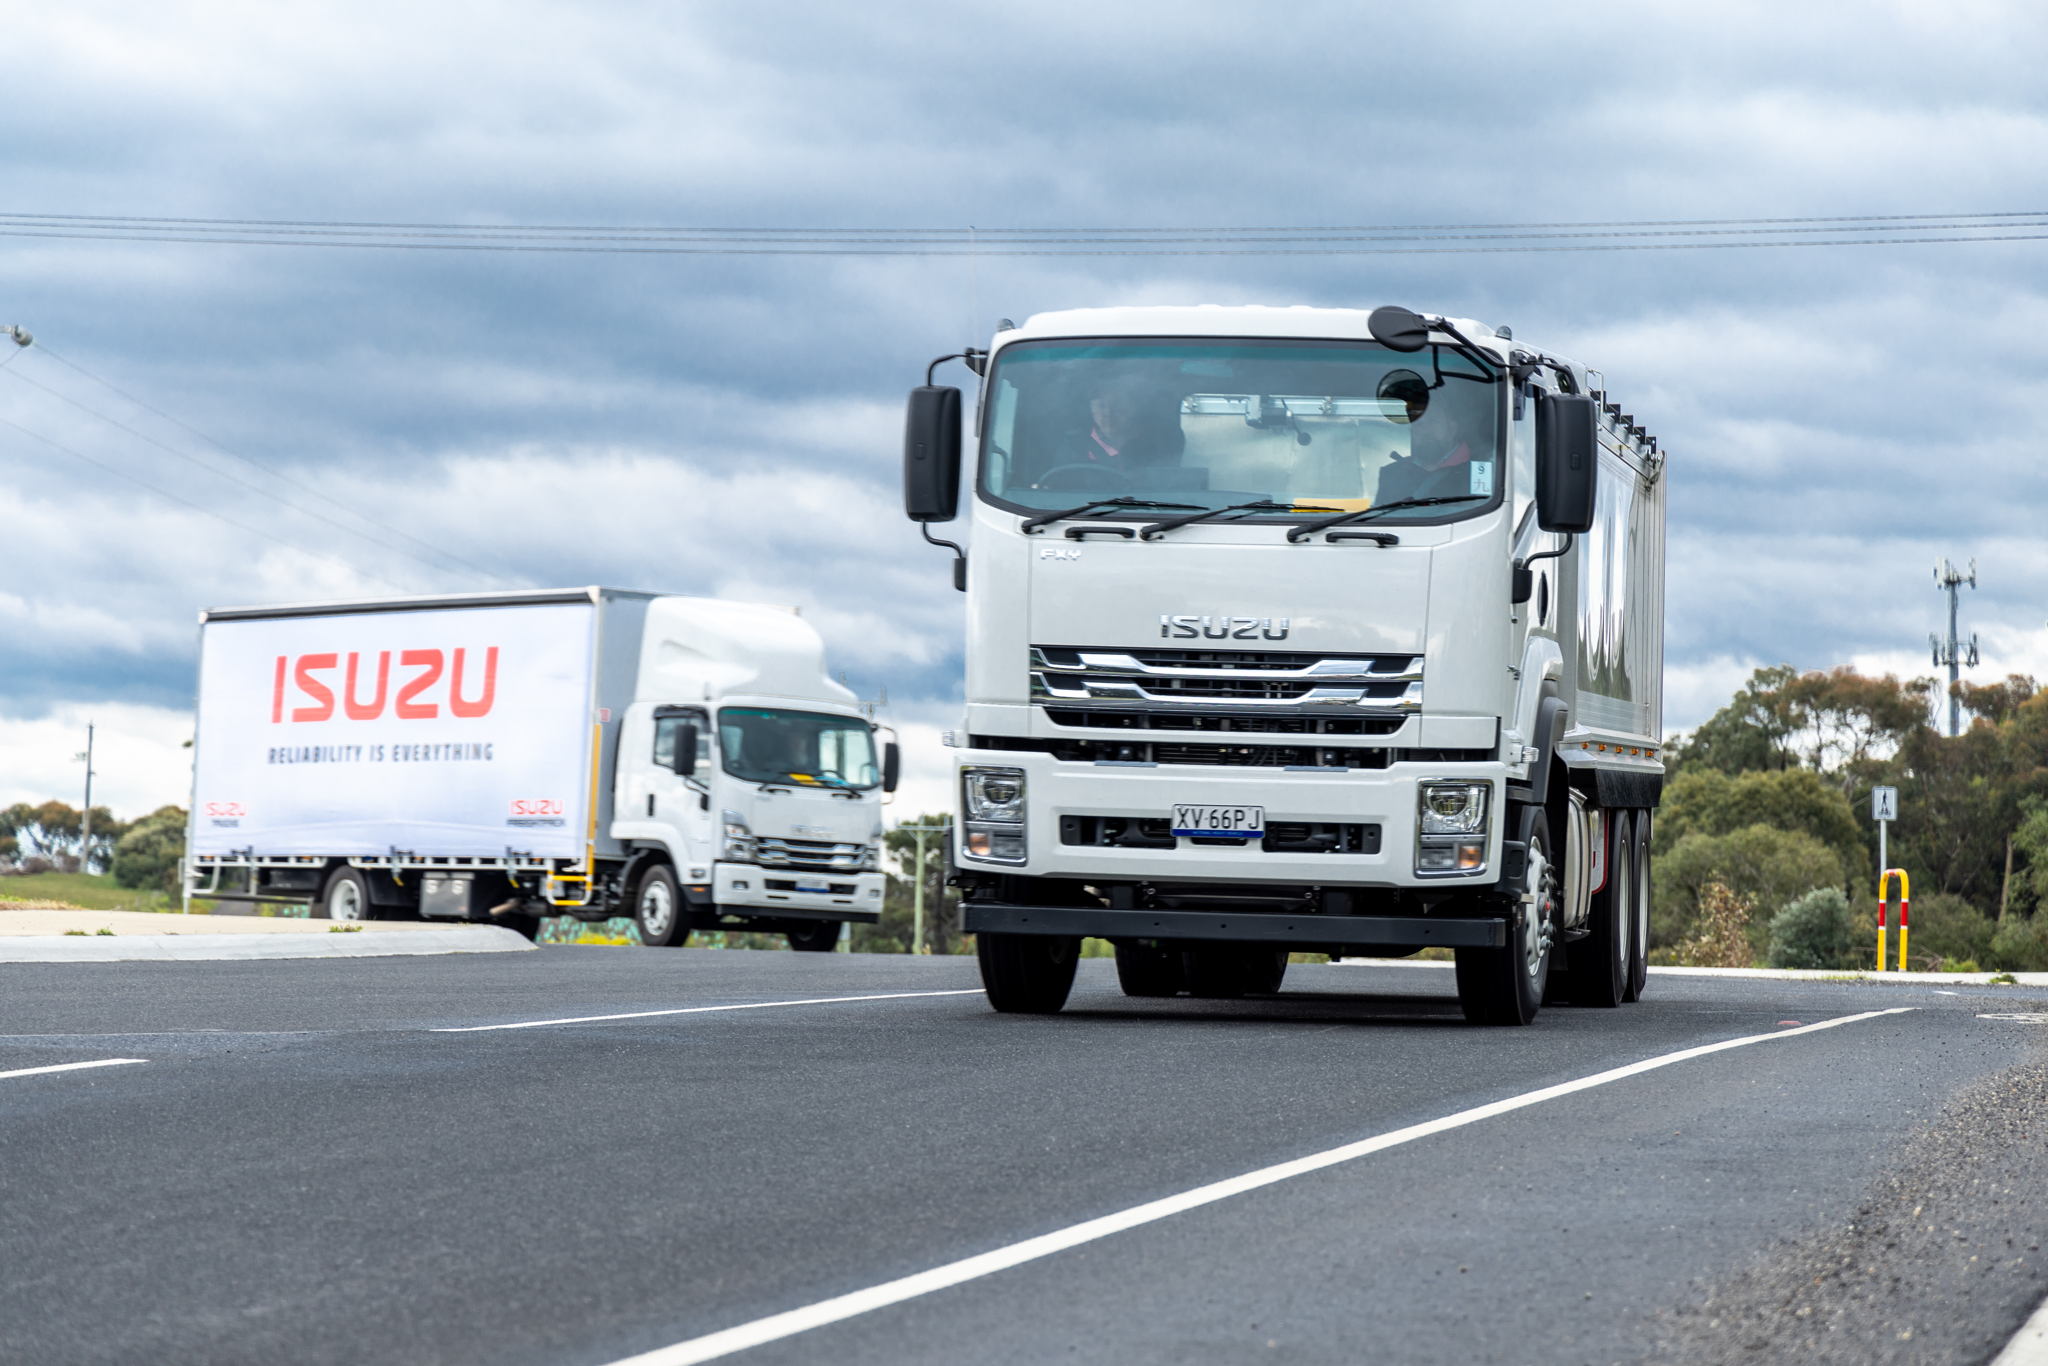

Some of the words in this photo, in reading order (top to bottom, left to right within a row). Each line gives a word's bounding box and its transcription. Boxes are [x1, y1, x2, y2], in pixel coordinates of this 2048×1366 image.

[1040, 549, 1081, 560] FXY
[1160, 615, 1288, 641] ISUZU
[272, 646, 499, 723] ISUZU
[268, 746, 361, 764] RELIABILITY
[369, 744, 384, 762] IS
[392, 742, 493, 762] EVERYTHING
